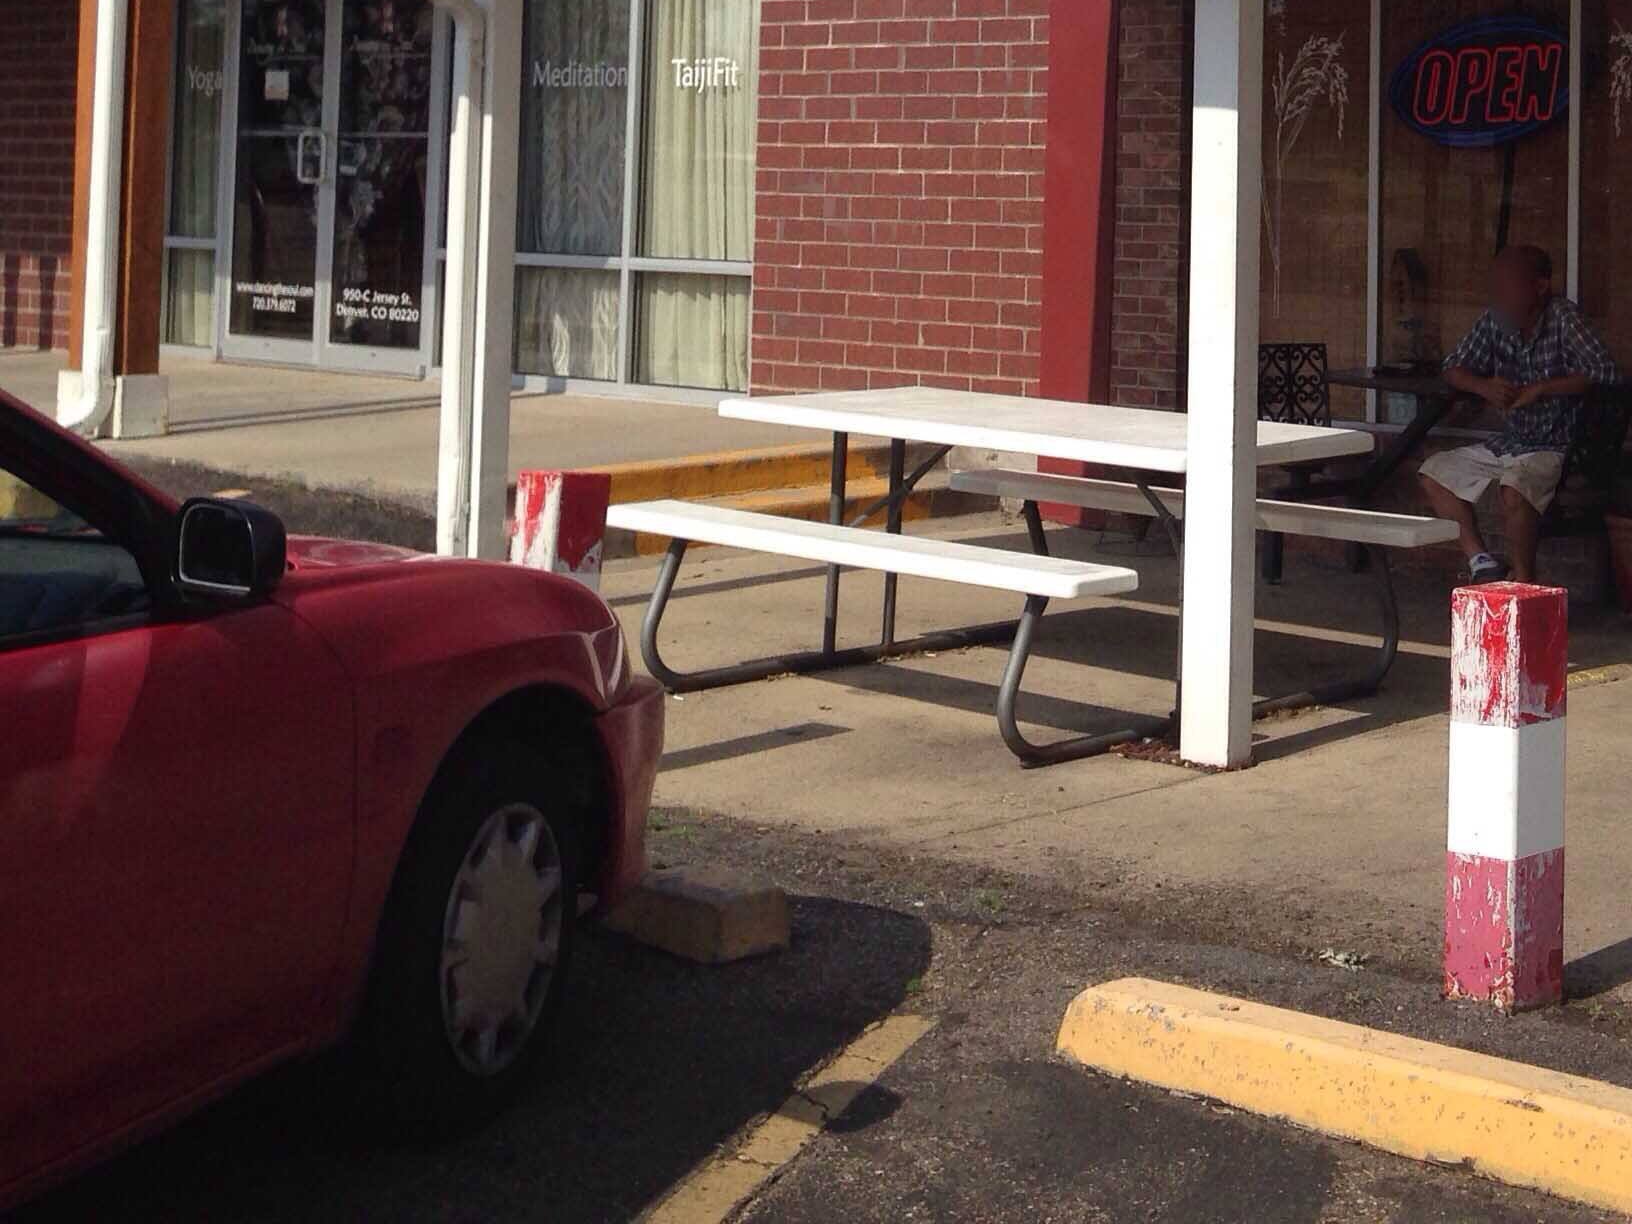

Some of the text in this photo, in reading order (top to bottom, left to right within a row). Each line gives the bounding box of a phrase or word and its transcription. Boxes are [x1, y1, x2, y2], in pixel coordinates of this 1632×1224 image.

[532, 59, 630, 89] Meditation
[671, 57, 740, 94] TaijiFit
[1413, 42, 1563, 125] OPEN
[342, 288, 413, 306] 950-C Jersey St.
[371, 306, 387, 320] CO
[388, 308, 420, 323] 80220
